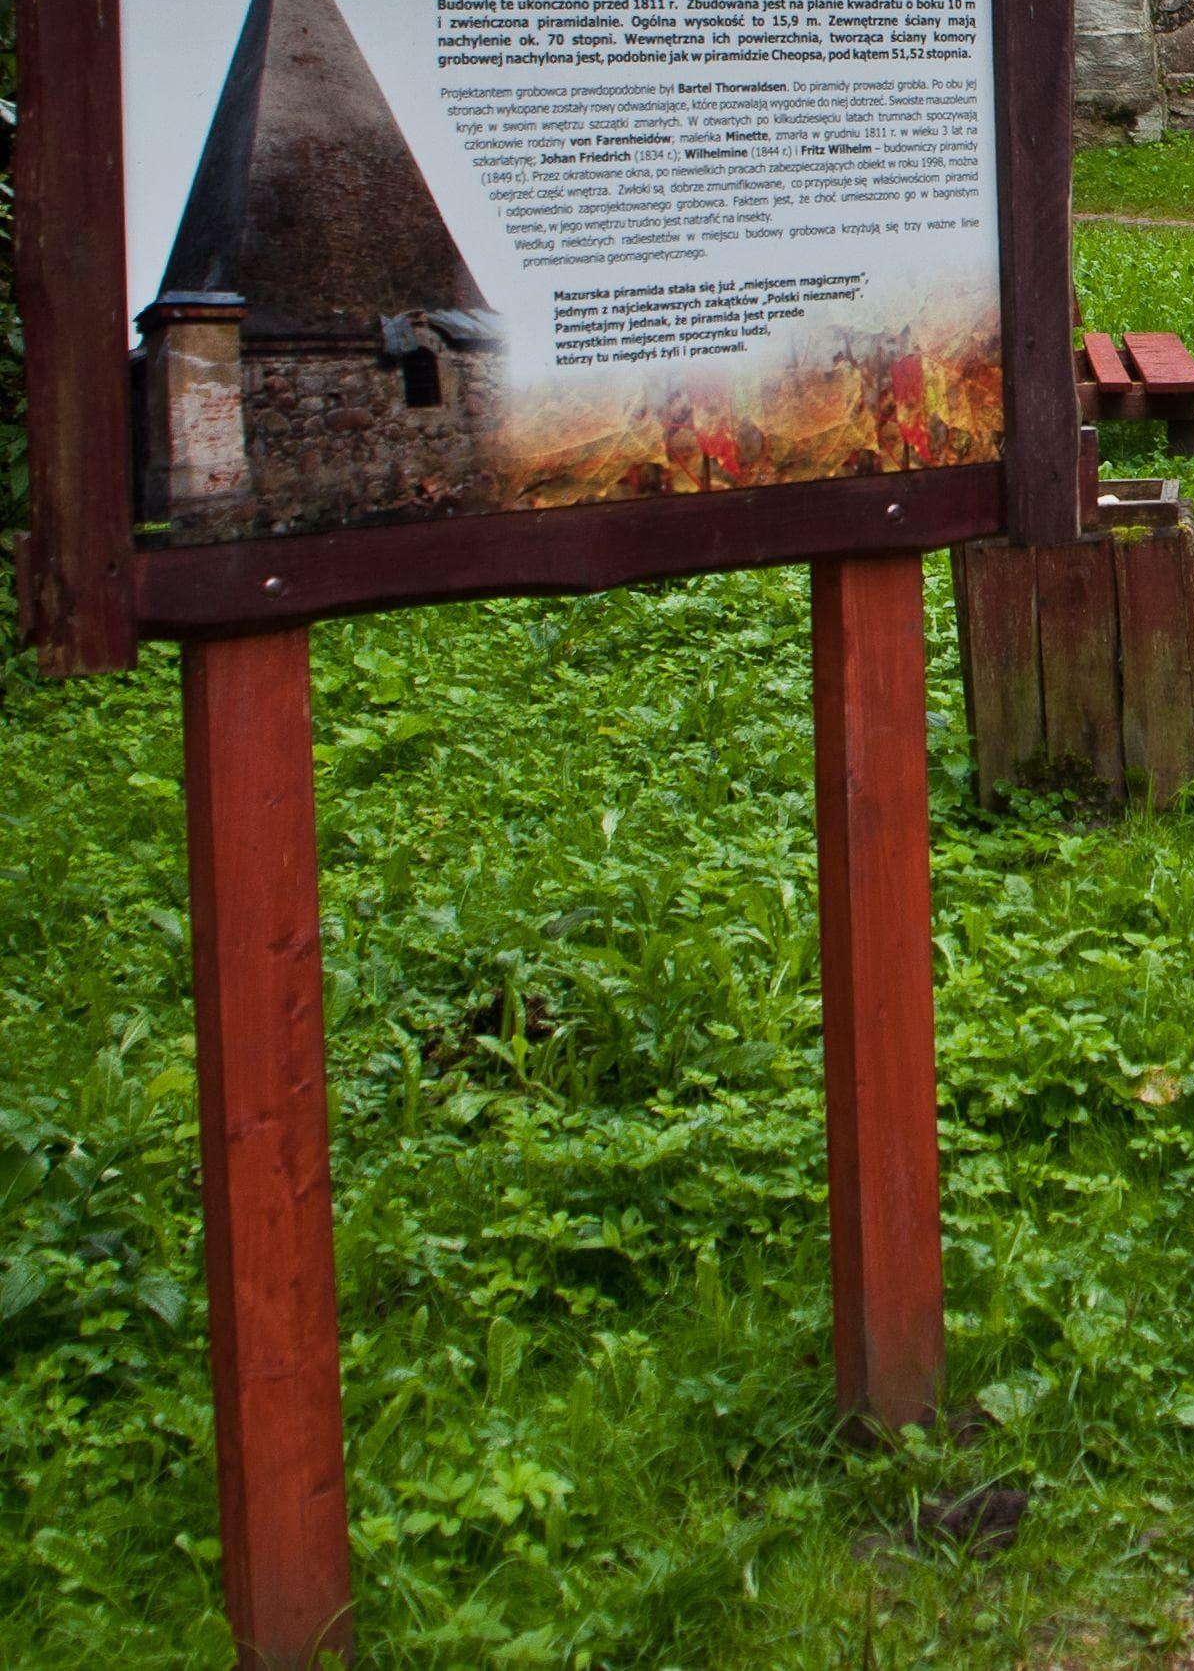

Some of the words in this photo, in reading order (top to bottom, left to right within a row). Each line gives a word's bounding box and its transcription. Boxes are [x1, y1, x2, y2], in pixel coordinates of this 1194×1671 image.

[669, 0, 678, 9] r.
[789, 0, 803, 9] na
[906, 0, 913, 9] o
[965, 0, 976, 9] m
[437, 17, 441, 28] i
[450, 16, 529, 28] zwieńczona
[538, 15, 623, 30] piramidalnie.
[631, 15, 676, 30] Ogólna
[684, 15, 744, 29] wysokość
[752, 15, 764, 26] to
[773, 15, 798, 28] 15,9
[807, 17, 821, 26] m.
[829, 14, 897, 29] Zewnętrzne
[905, 14, 940, 29] ściany
[948, 14, 976, 29] mają
[437, 34, 511, 49] nachylenie
[519, 34, 539, 45] ok.
[548, 33, 564, 45] 70
[572, 33, 616, 47] stopni.
[625, 32, 704, 47] Wewnętrzna
[713, 32, 730, 43] ich
[738, 31, 822, 46] powierzchnia,
[830, 31, 883, 45] tworząca
[891, 31, 926, 45] ściany
[934, 31, 977, 45] komory
[437, 52, 502, 68] grobowej
[506, 52, 573, 66] nachylona
[576, 51, 604, 66] jest,
[607, 50, 666, 65] podobnie
[670, 50, 688, 64] jak
[691, 52, 702, 61] w
[705, 49, 769, 64] piramidzie
[772, 49, 825, 63] Cheopsa,
[829, 48, 850, 62] pod
[853, 48, 889, 62] kątem
[892, 47, 924, 60] 51,52
[926, 47, 972, 61] stopnia.
[553, 288, 610, 301] Mazurska
[614, 285, 664, 300] piramida
[668, 283, 695, 294] stała
[699, 281, 715, 295] się
[718, 280, 735, 294] już
[553, 306, 598, 320] jednym
[601, 306, 608, 314] z
[612, 298, 701, 316] najciekawszych
[705, 295, 758, 309] zakątków
[554, 319, 625, 334] Pamiętajmy
[629, 315, 670, 331] jednak,
[675, 314, 687, 325] że
[691, 311, 740, 327] piramida
[744, 309, 764, 323] jest
[768, 307, 805, 322] przede
[554, 335, 617, 350] wszystkim
[621, 333, 675, 346] miejscem
[679, 327, 737, 343] spoczynku
[741, 324, 771, 336] ludzi,
[555, 354, 592, 366] którzy
[597, 352, 608, 362] tu
[613, 348, 657, 363] niegdyś
[661, 346, 679, 360] żyli
[683, 345, 686, 356] i
[690, 341, 748, 358] pracowali.
